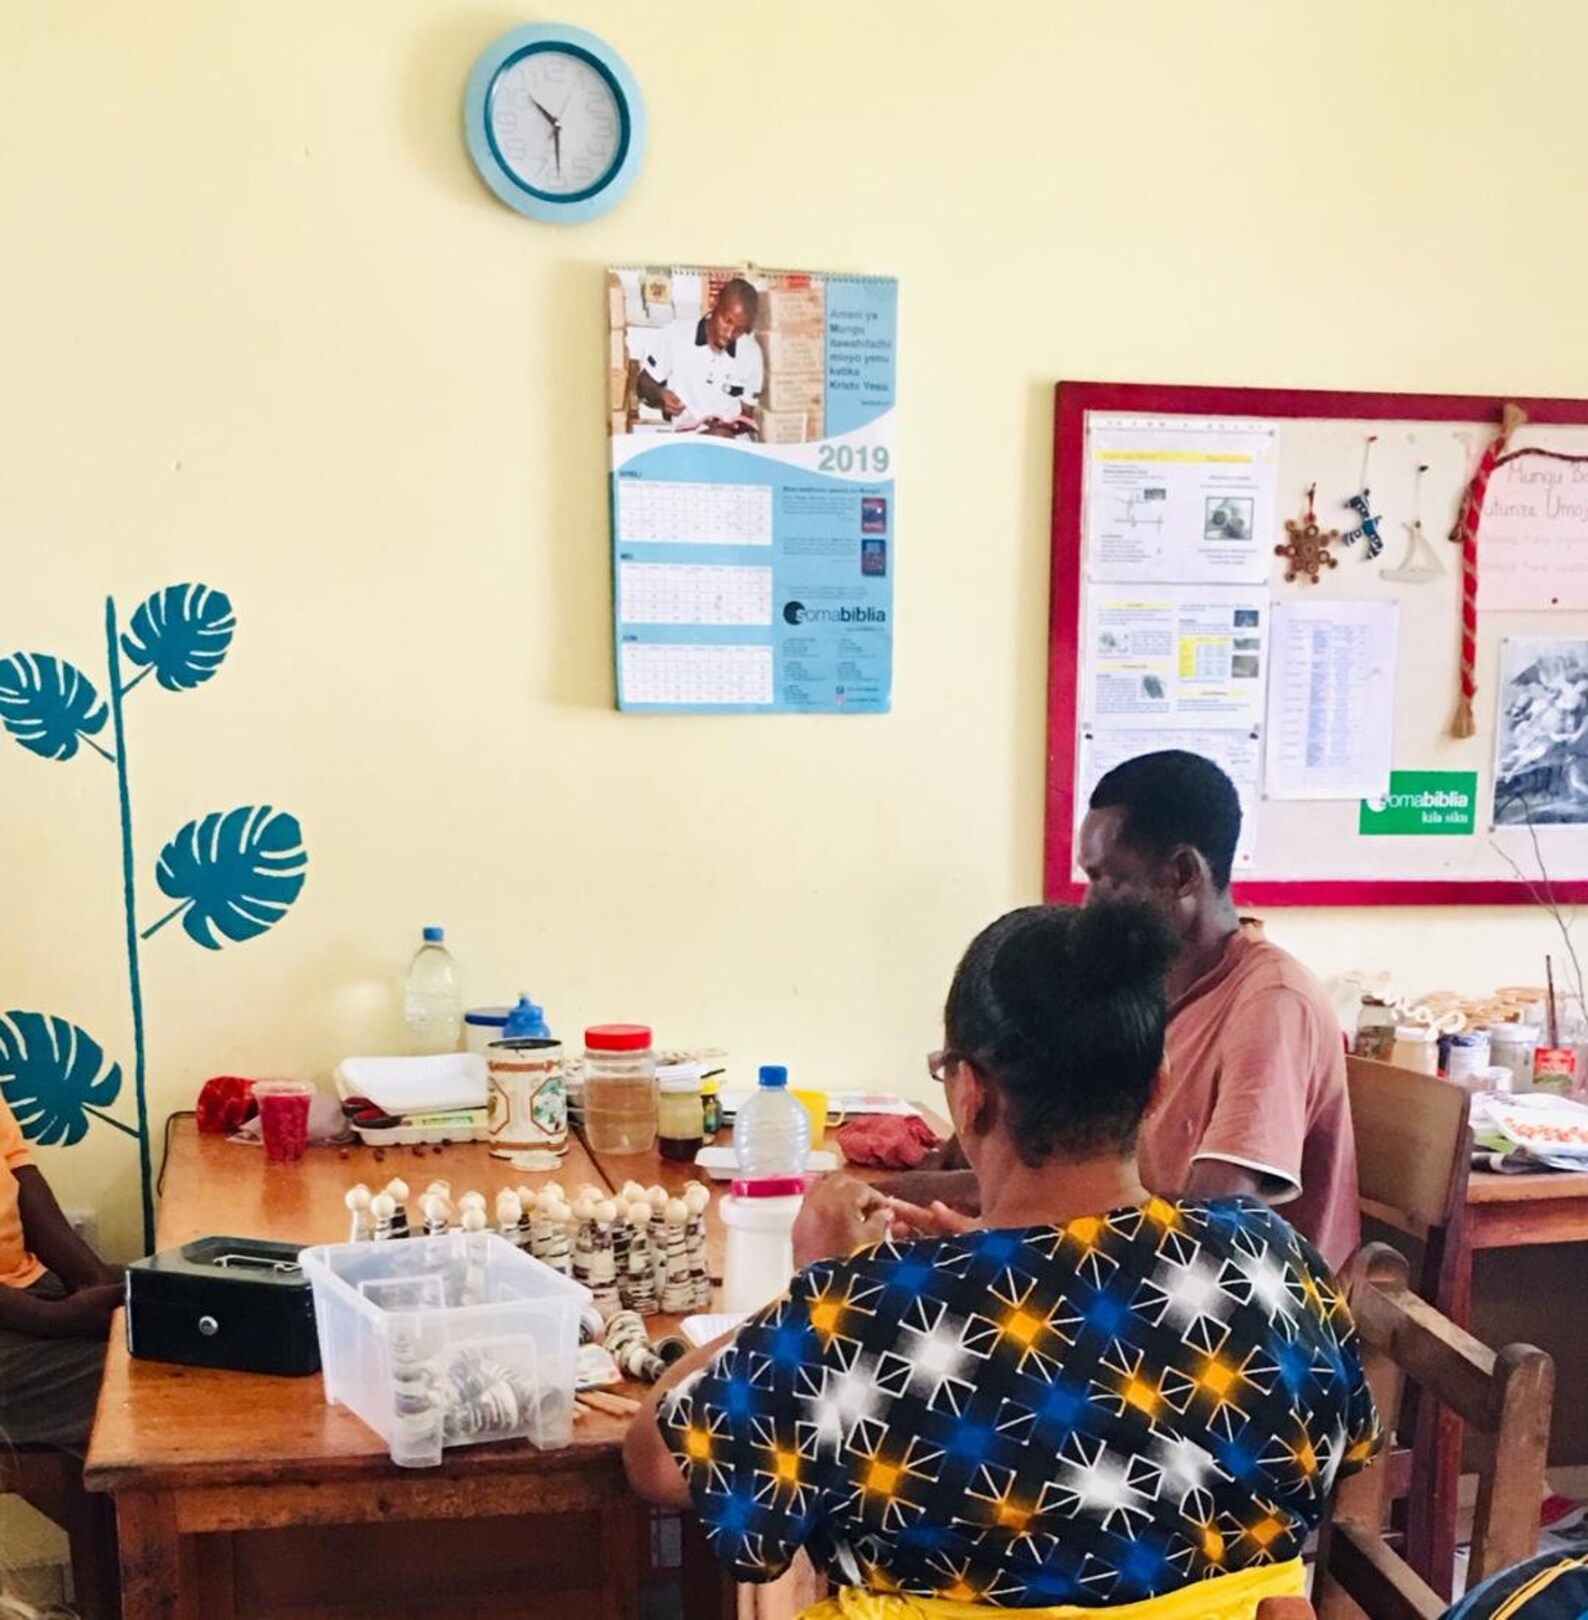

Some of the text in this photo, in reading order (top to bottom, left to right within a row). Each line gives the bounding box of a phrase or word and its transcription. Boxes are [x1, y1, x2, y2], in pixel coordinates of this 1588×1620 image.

[497, 112, 518, 134] 9
[591, 116, 613, 138] 3
[528, 155, 549, 178] 7
[571, 157, 594, 181] 5
[818, 444, 890, 473] 2019
[795, 606, 886, 622] somabiblia
